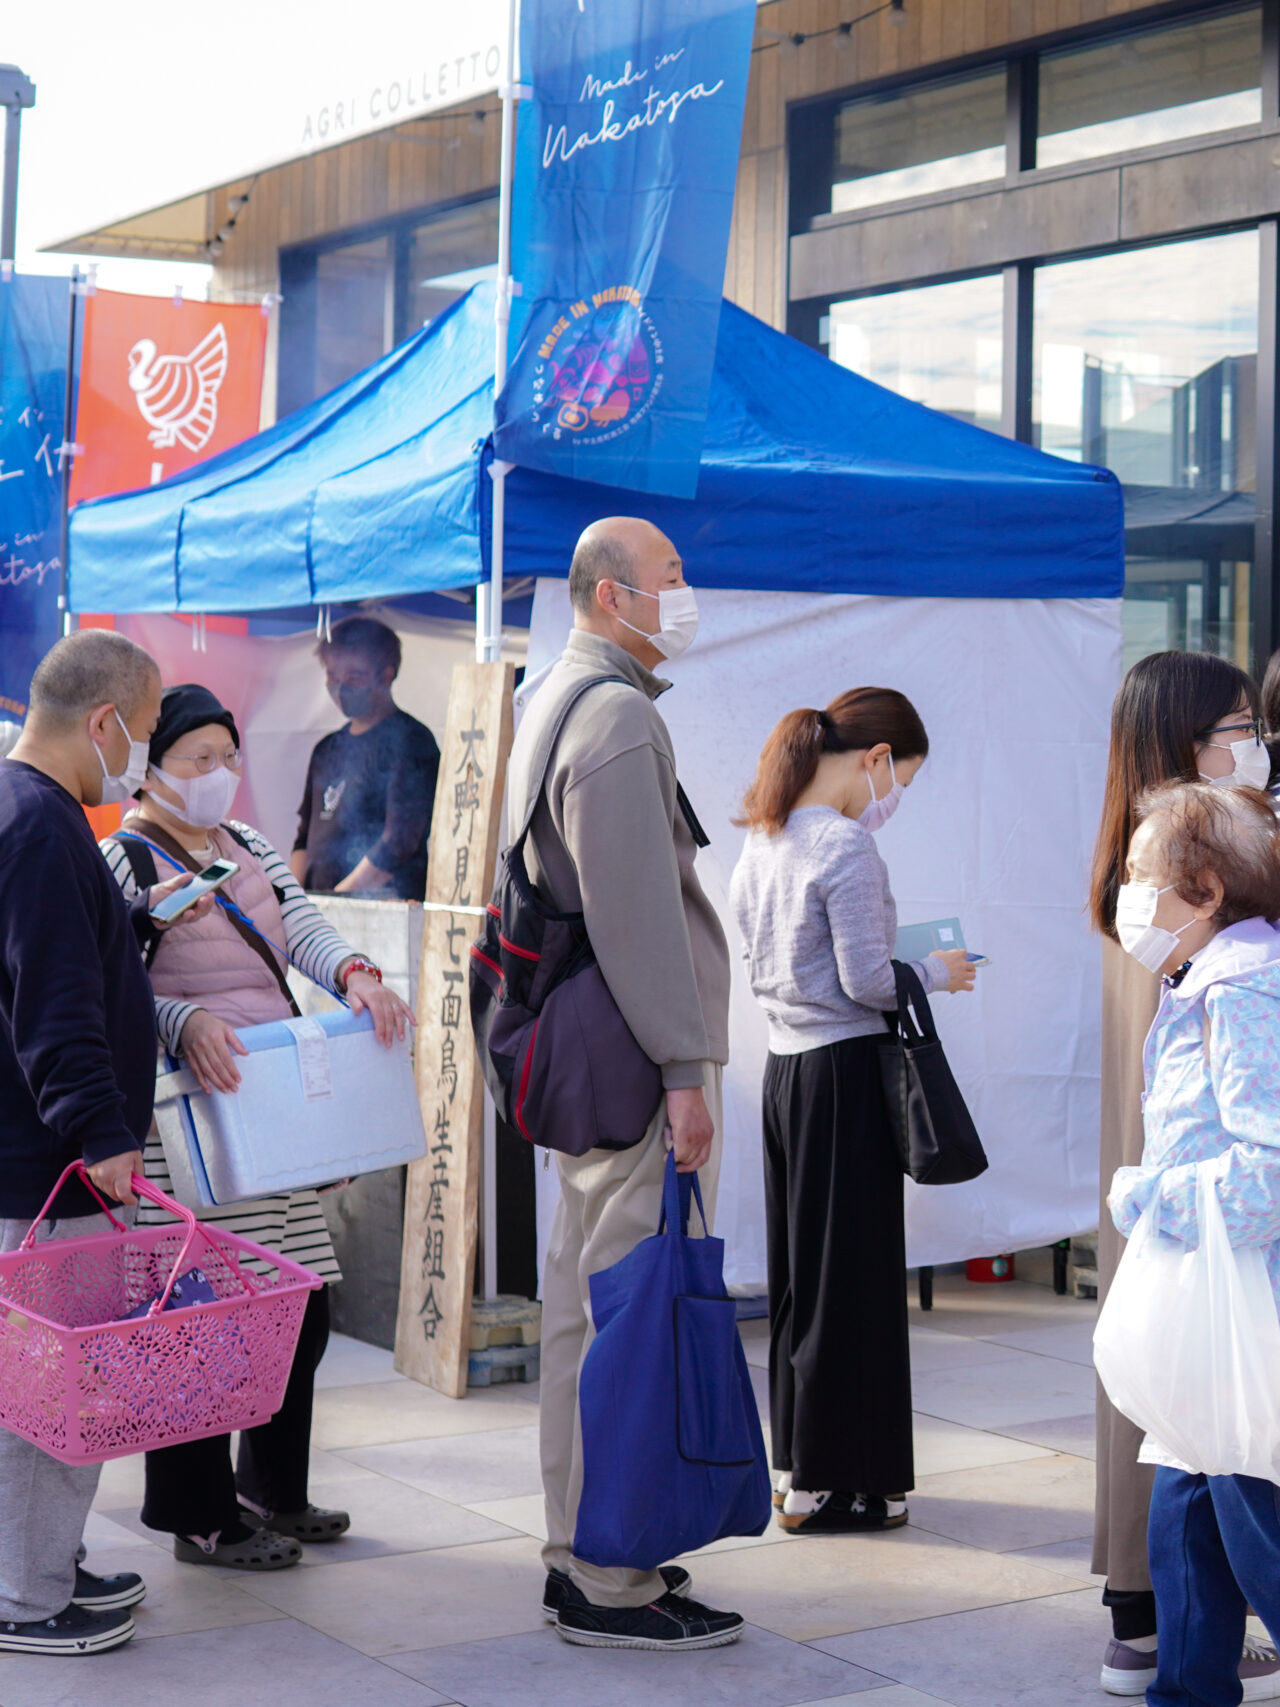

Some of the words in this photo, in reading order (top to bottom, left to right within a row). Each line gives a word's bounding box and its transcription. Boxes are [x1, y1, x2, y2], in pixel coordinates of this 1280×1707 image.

[302, 97, 356, 142] AGRI
[369, 45, 501, 119] COLLETTO
[579, 60, 648, 103] Made
[654, 48, 685, 71] in
[537, 315, 571, 360] MADE
[569, 299, 590, 319] IN
[417, 706, 486, 1342] 大野見七面鳥生産組合
